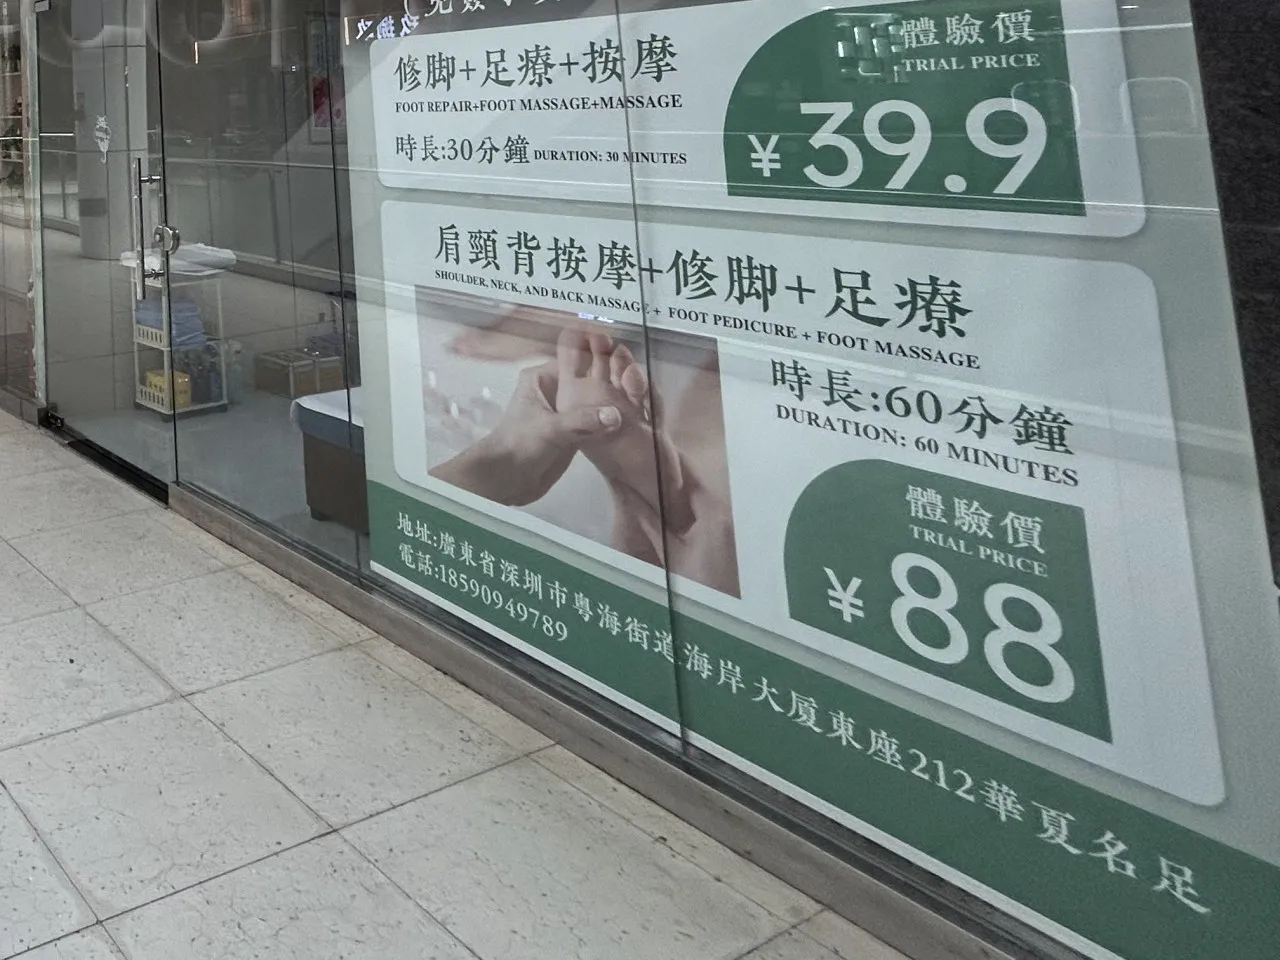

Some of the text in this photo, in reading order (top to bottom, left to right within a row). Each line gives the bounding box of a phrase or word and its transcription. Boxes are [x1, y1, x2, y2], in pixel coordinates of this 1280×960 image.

[899, 8, 1037, 50] 體驗價
[901, 52, 1041, 72] TRIAL PRICE
[395, 94, 683, 114] FOOT REPAIR+FOOT MASSAGE+MASSAGE
[533, 149, 603, 163] DURATION:
[606, 150, 620, 163] 30
[622, 150, 688, 166] MINUTES
[434, 269, 489, 288] SHOULDER,
[491, 278, 521, 294] NECK,
[524, 285, 549, 299] AND
[551, 289, 585, 304] BACK
[668, 306, 709, 325] FOOT
[713, 313, 798, 340] PEDICURE
[816, 330, 869, 352] FOOT
[874, 340, 981, 370] MASSAGE
[776, 403, 1080, 487] DURATION: 60 MINUTES
[905, 483, 1046, 555] 體驗價
[909, 523, 1049, 578] TRIAL PRICE
